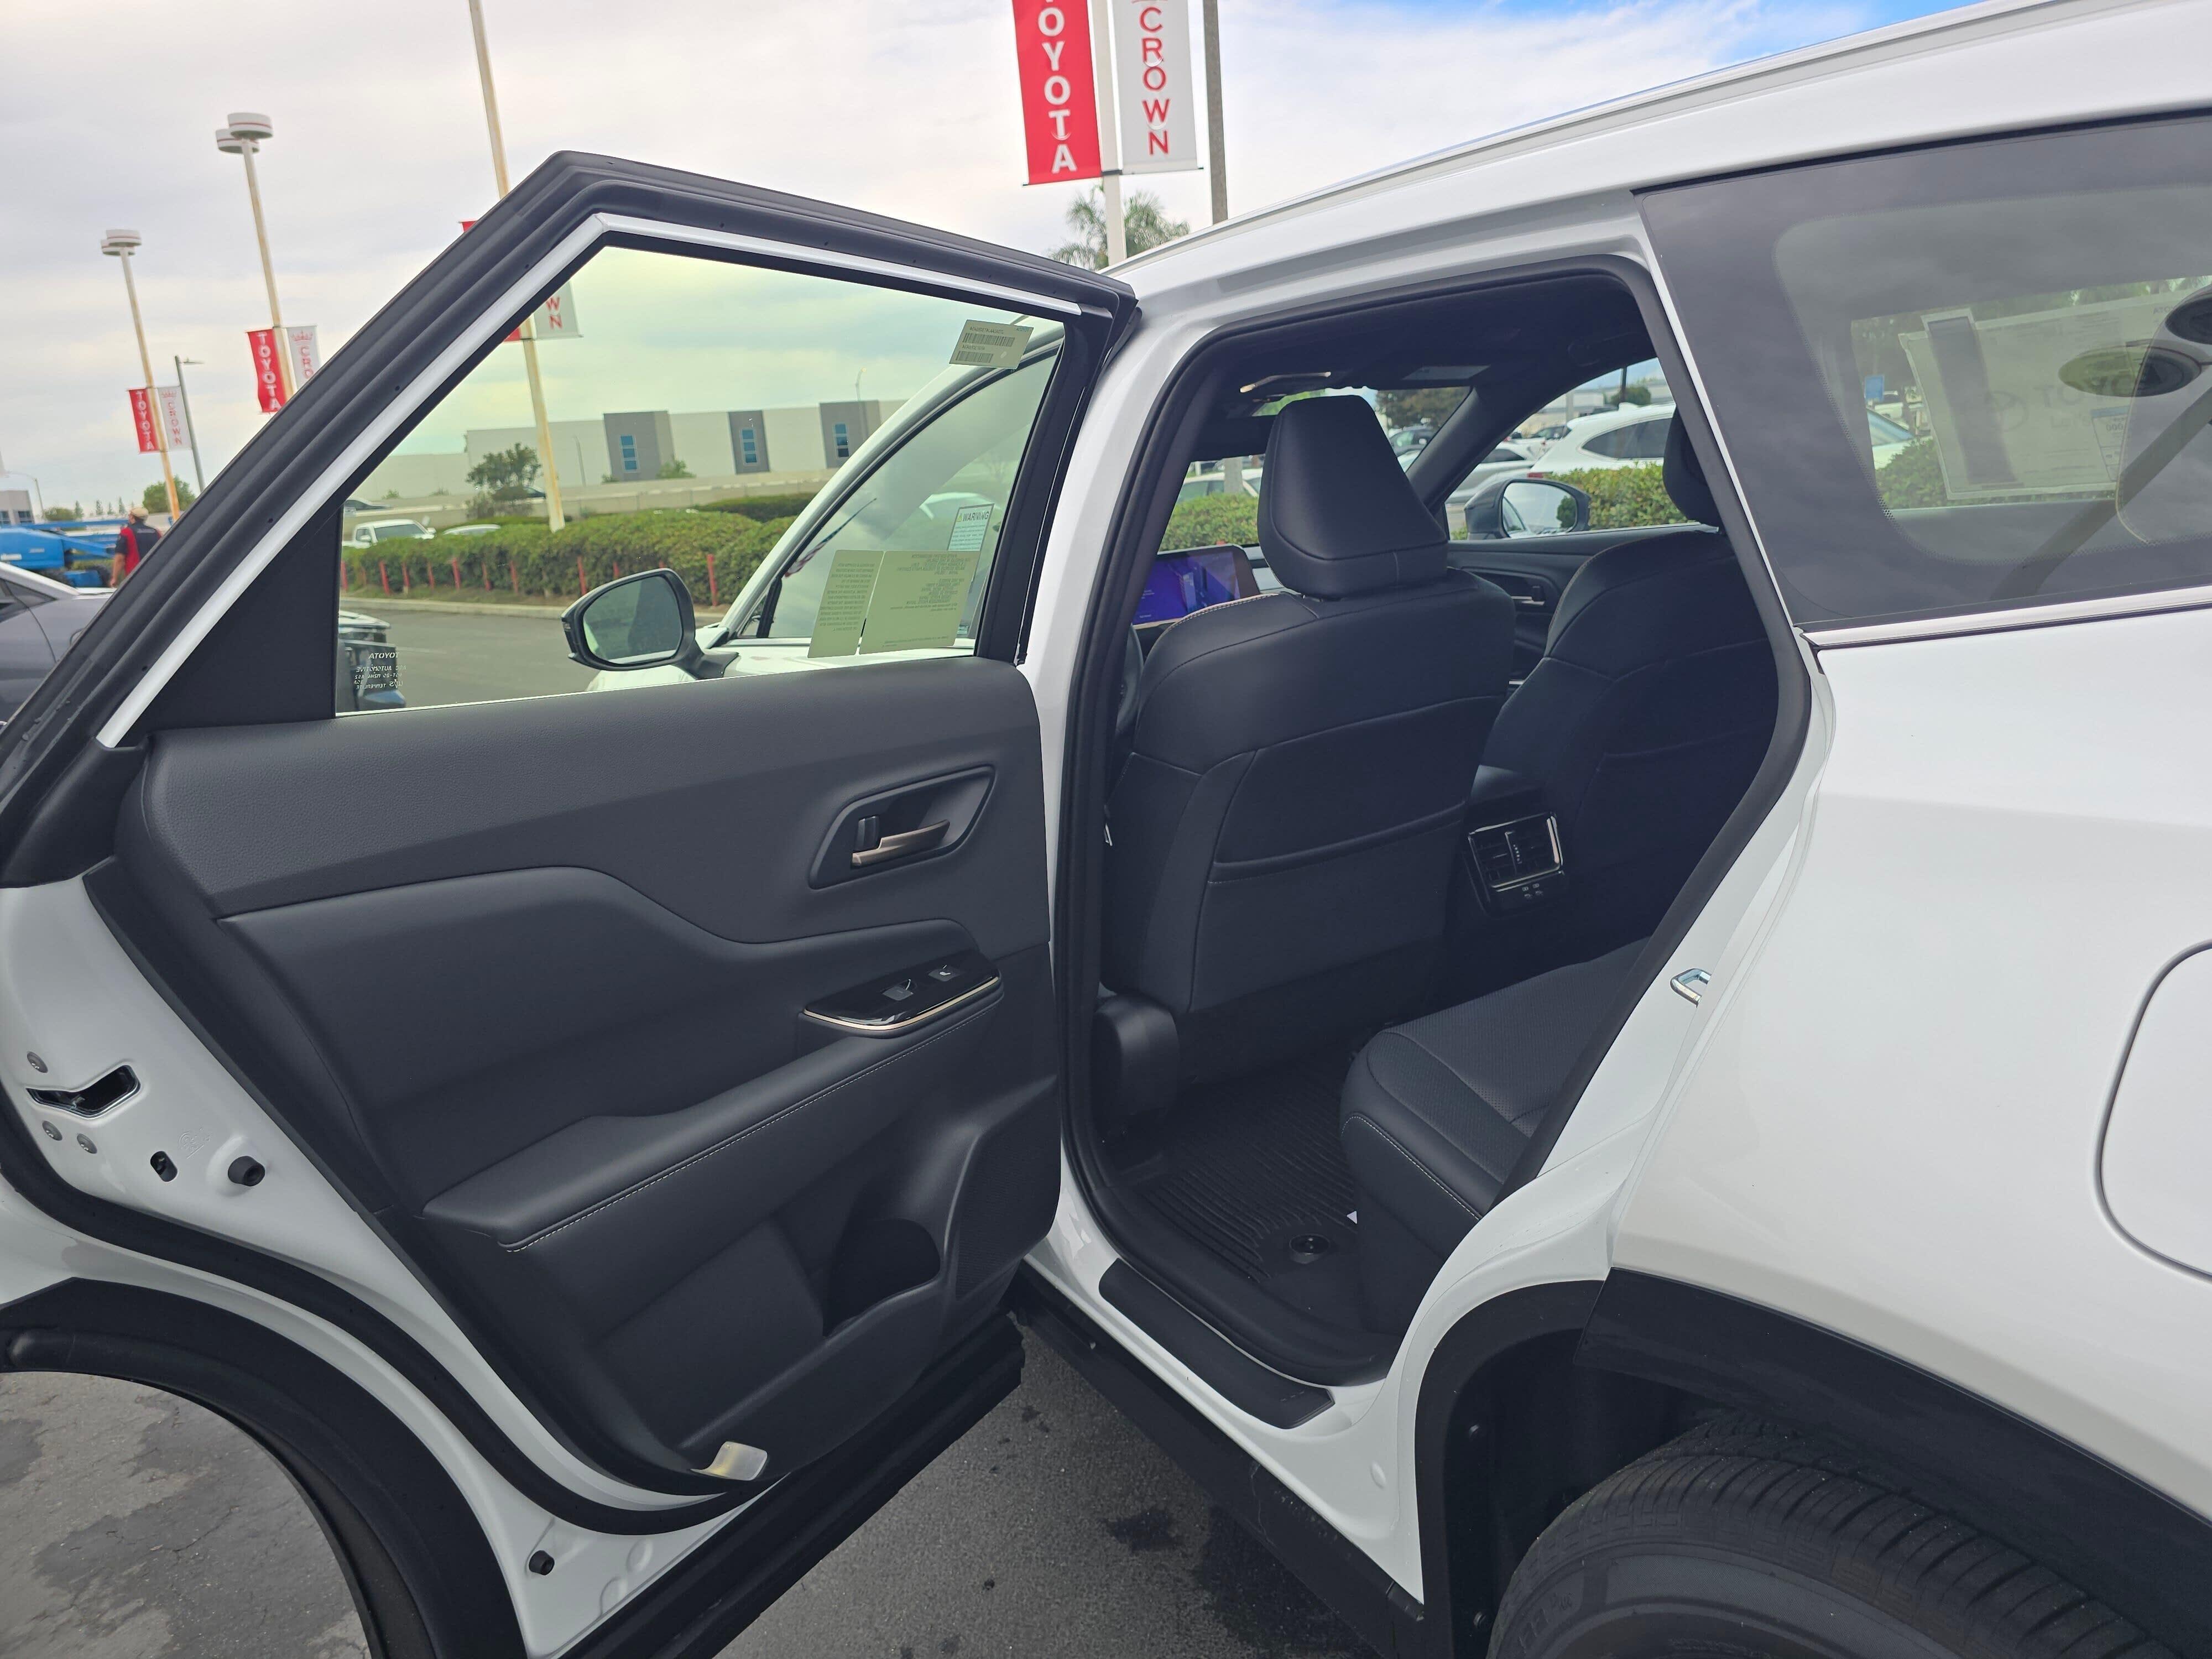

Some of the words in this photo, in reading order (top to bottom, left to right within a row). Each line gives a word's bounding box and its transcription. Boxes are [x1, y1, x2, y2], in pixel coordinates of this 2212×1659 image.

[1037, 0, 1078, 174] OYOTA
[1139, 6, 1171, 156] CROWN
[256, 332, 283, 412] TOYOTA
[299, 344, 314, 380] CRO
[136, 390, 155, 451] TOYOTA
[963, 511, 989, 521] WARNING
